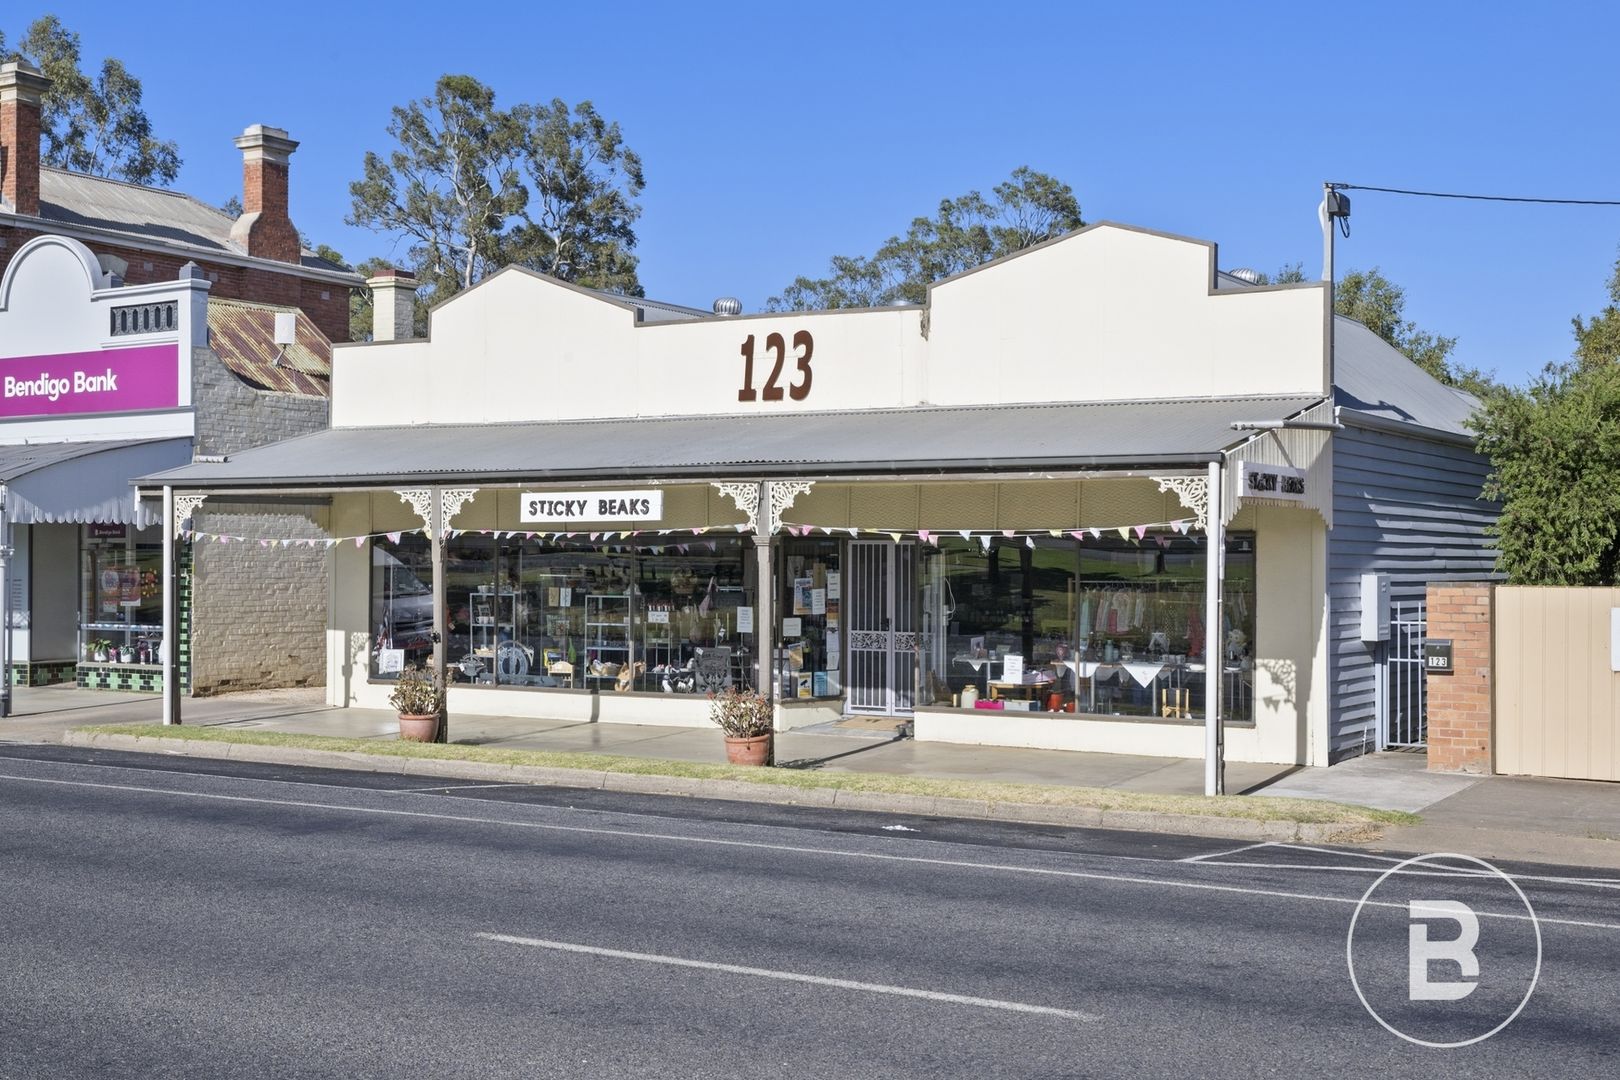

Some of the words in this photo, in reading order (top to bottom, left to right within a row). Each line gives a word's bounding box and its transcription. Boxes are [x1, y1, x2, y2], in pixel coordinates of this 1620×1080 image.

[738, 330, 814, 402] 123
[4, 373, 70, 401] Bendigo
[74, 368, 118, 393] Bank
[528, 499, 588, 517] STICKY
[598, 498, 650, 516] BEAKS
[1430, 657, 1446, 666] 123
